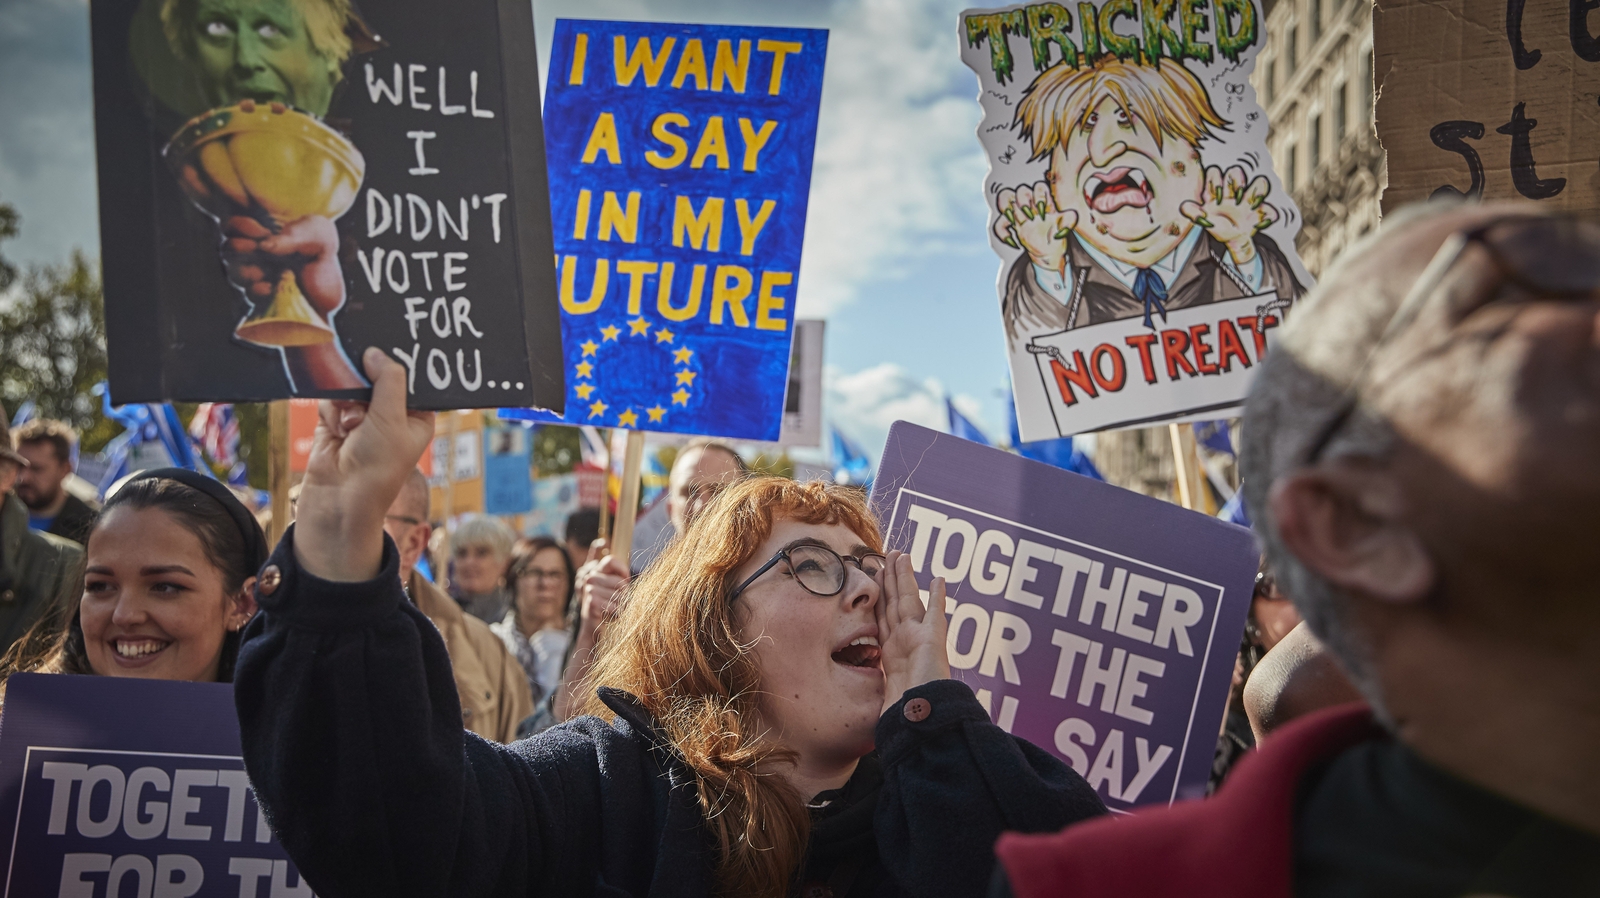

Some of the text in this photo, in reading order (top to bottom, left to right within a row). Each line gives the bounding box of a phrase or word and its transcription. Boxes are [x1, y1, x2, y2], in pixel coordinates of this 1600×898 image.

[569, 33, 803, 96] I WANT
[964, 0, 1259, 87] TRICKED
[364, 63, 495, 118] WELL
[406, 130, 440, 175] I
[581, 112, 779, 172] A SAY
[366, 188, 507, 243] DIDN'T
[573, 189, 777, 256] IN MY
[357, 247, 469, 293] VOTE
[554, 253, 793, 331] UTURE
[404, 296, 483, 340] FOR
[1048, 343, 1127, 408] NO
[908, 503, 1204, 658] TOGETHER
[919, 589, 1032, 686] OR
[1050, 628, 1166, 726] THE
[1053, 716, 1173, 804] SAY
[41, 761, 273, 843] TOGET
[228, 856, 318, 898] TH
